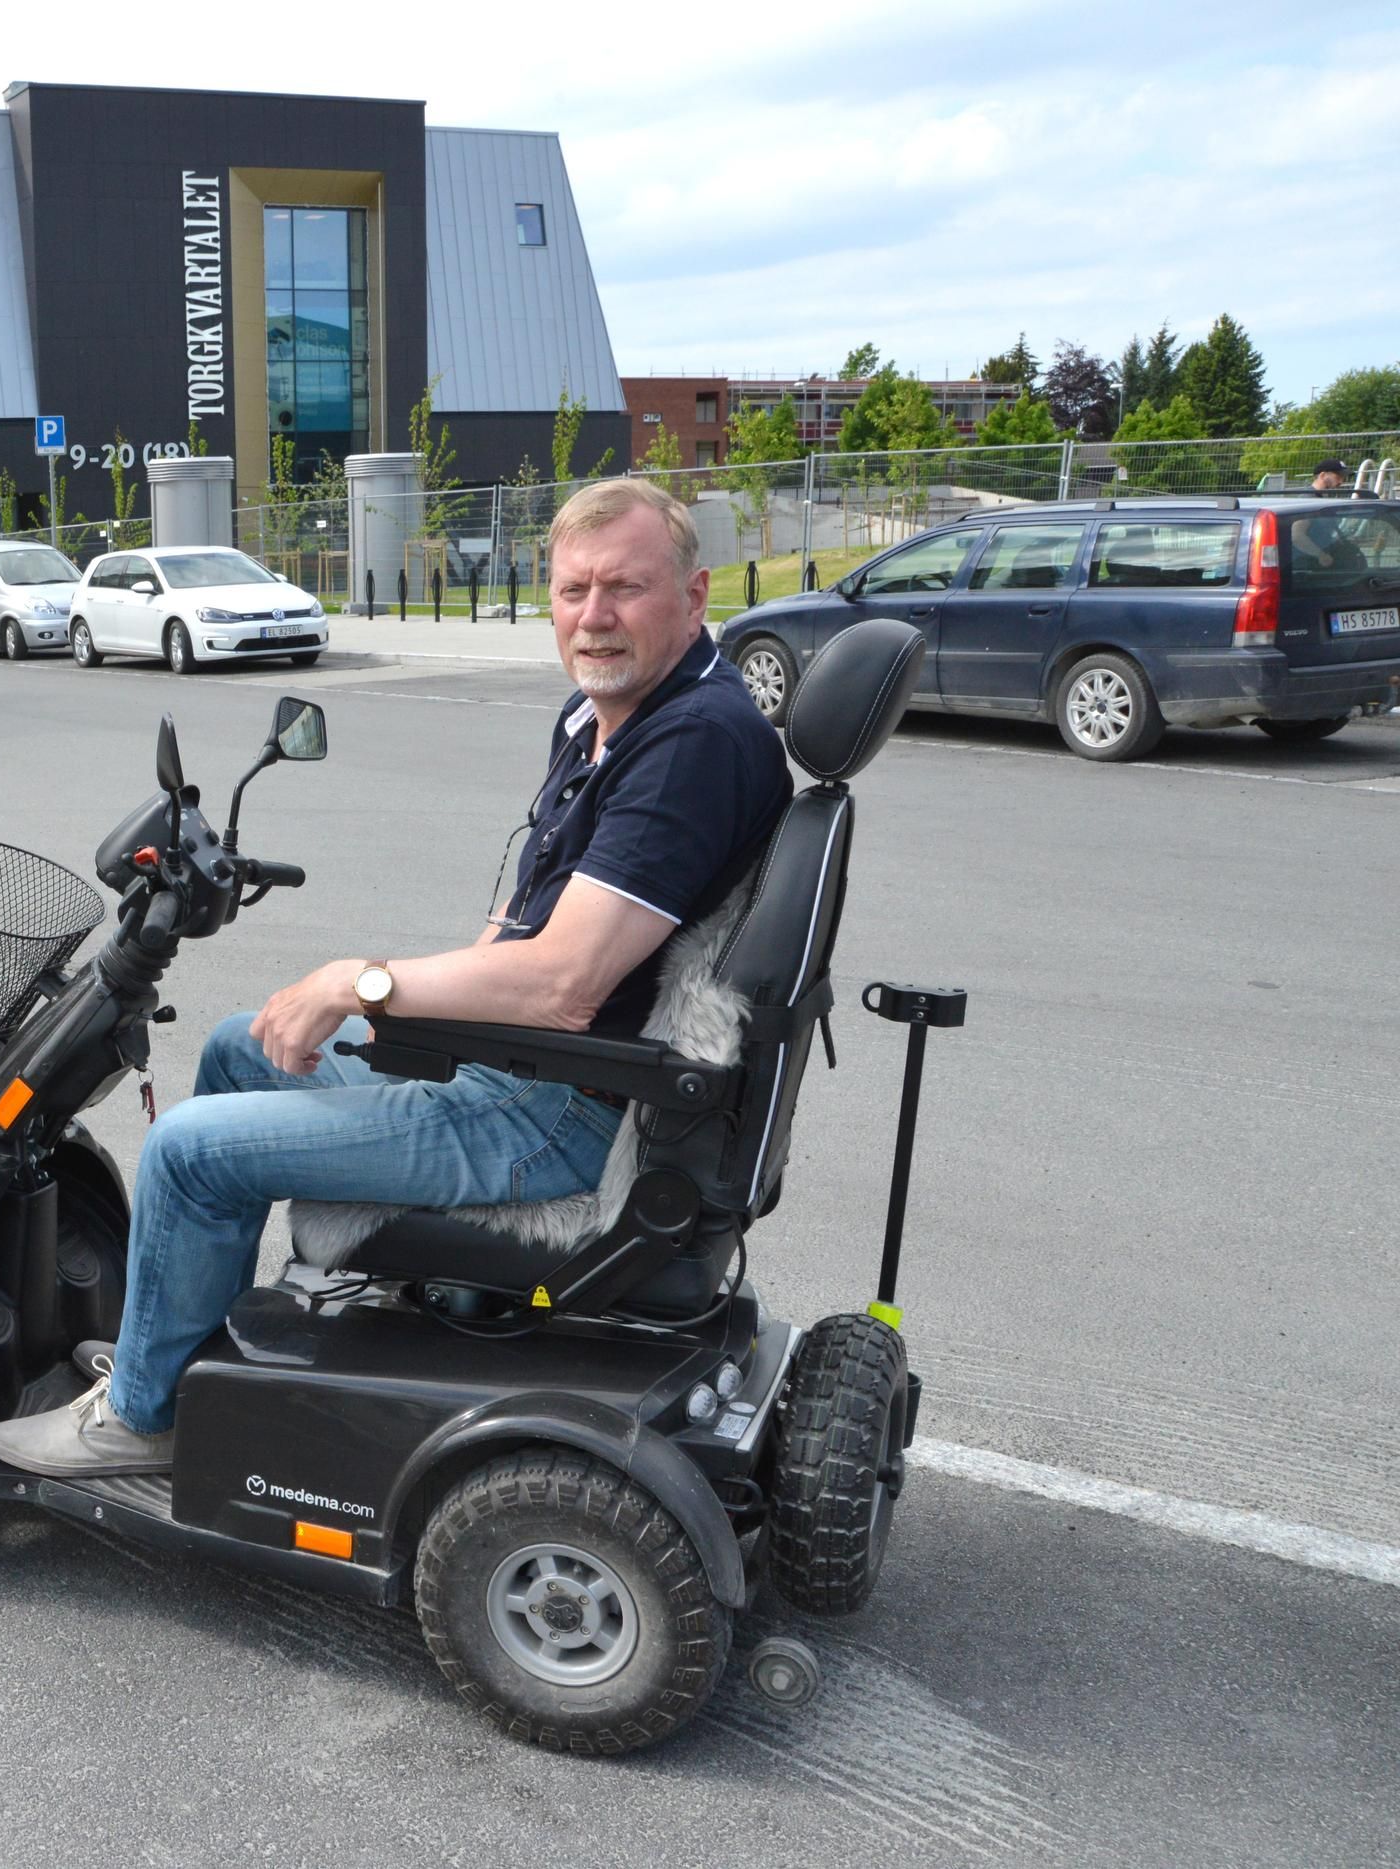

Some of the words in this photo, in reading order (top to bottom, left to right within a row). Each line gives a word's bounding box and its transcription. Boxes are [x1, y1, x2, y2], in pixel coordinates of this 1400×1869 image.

[182, 170, 225, 420] TORGKVARTALET
[42, 420, 58, 444] P
[70, 443, 135, 471] 9-20
[1341, 613, 1357, 630] HS
[1361, 610, 1396, 628] 85778
[270, 1484, 375, 1519] medema.com
